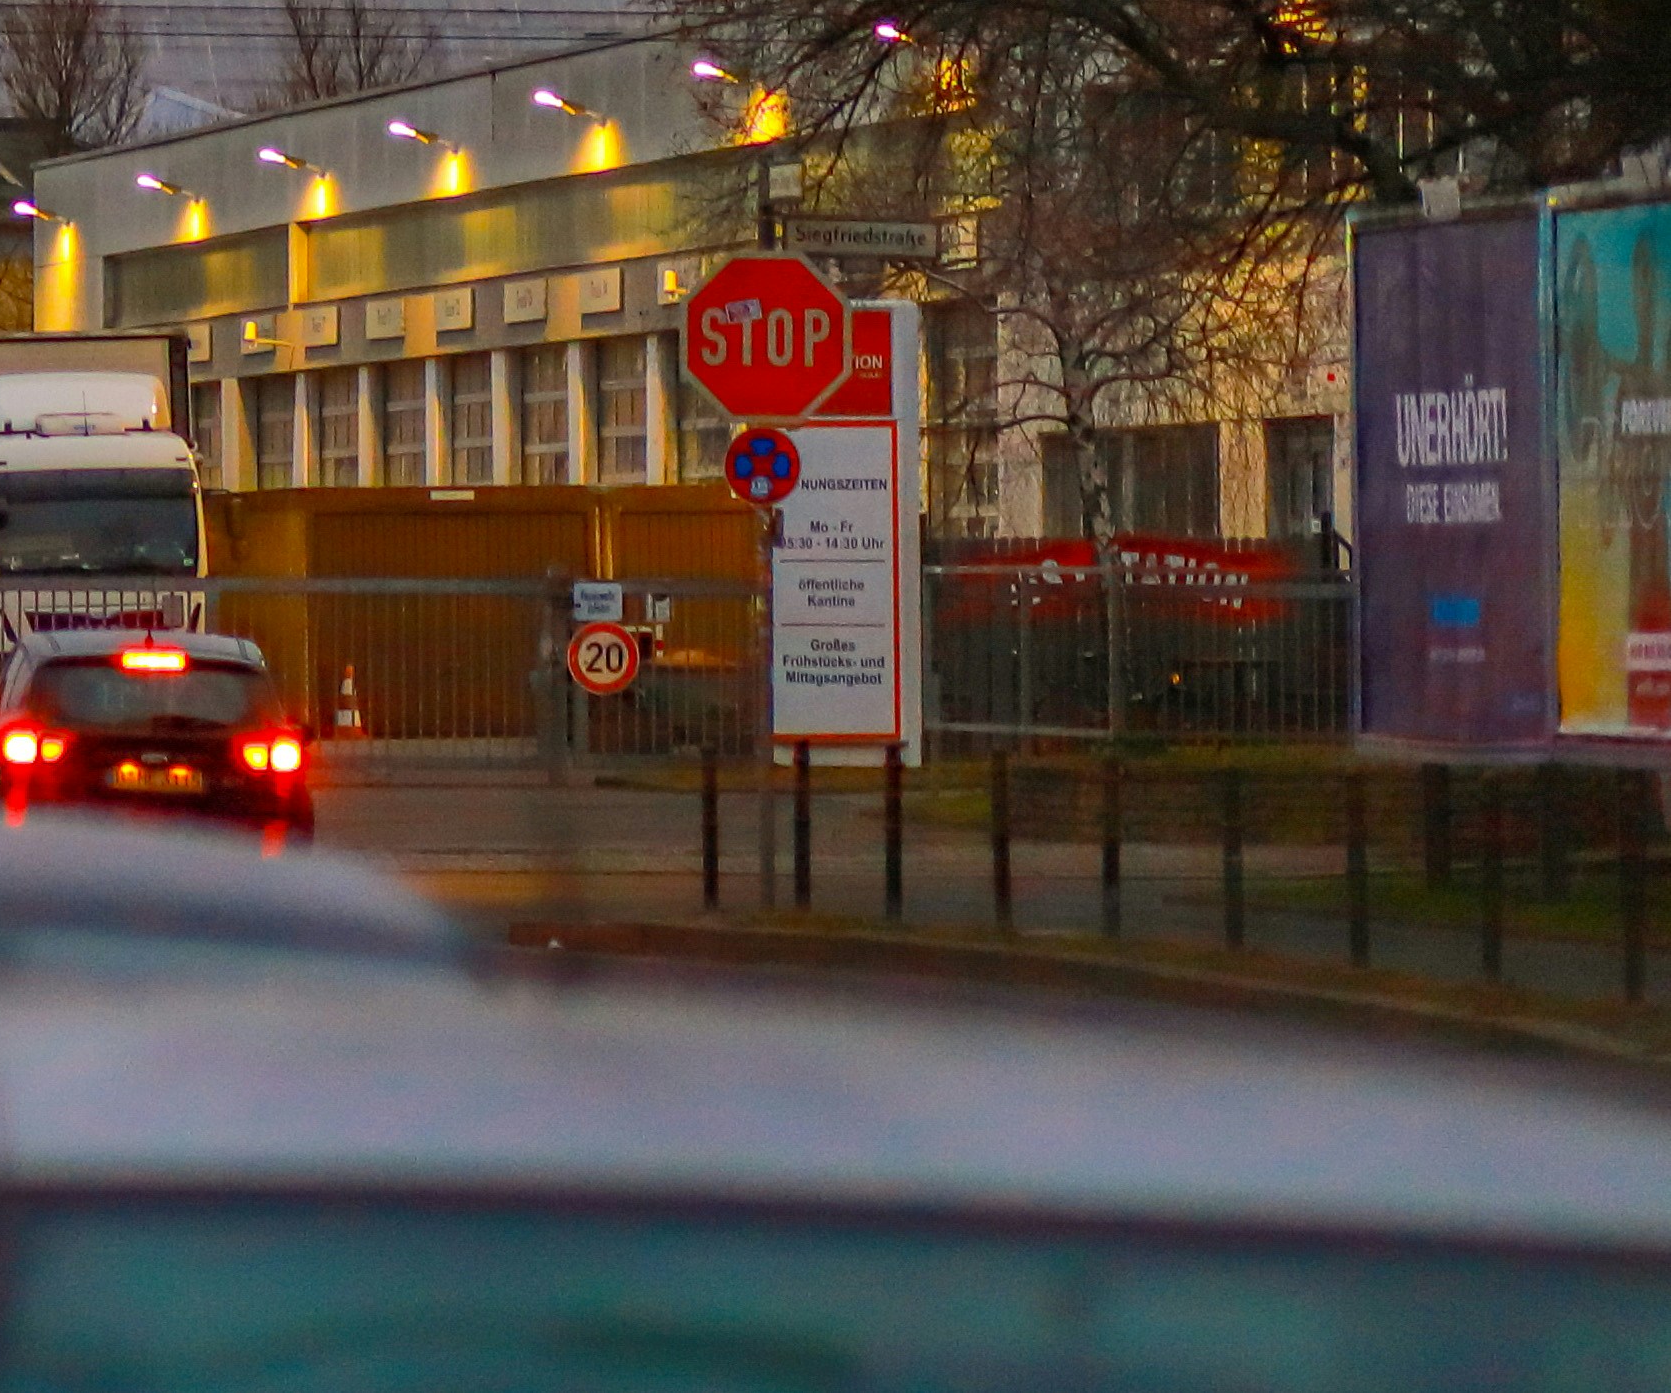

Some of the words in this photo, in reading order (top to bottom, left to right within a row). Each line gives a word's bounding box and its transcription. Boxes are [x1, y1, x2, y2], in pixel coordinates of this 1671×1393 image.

[701, 306, 830, 368] STOP
[850, 354, 883, 370] ION
[1396, 373, 1508, 468] UNERHÖRT!
[810, 520, 829, 533] Mo
[840, 520, 854, 533] Fr
[862, 536, 885, 549] Uhr
[798, 578, 865, 592] öffentliche
[807, 594, 856, 608] Kantine
[810, 638, 857, 652] Großes
[586, 642, 623, 673] 20
[860, 655, 885, 669] und
[785, 670, 883, 687] Mittagsangebot
